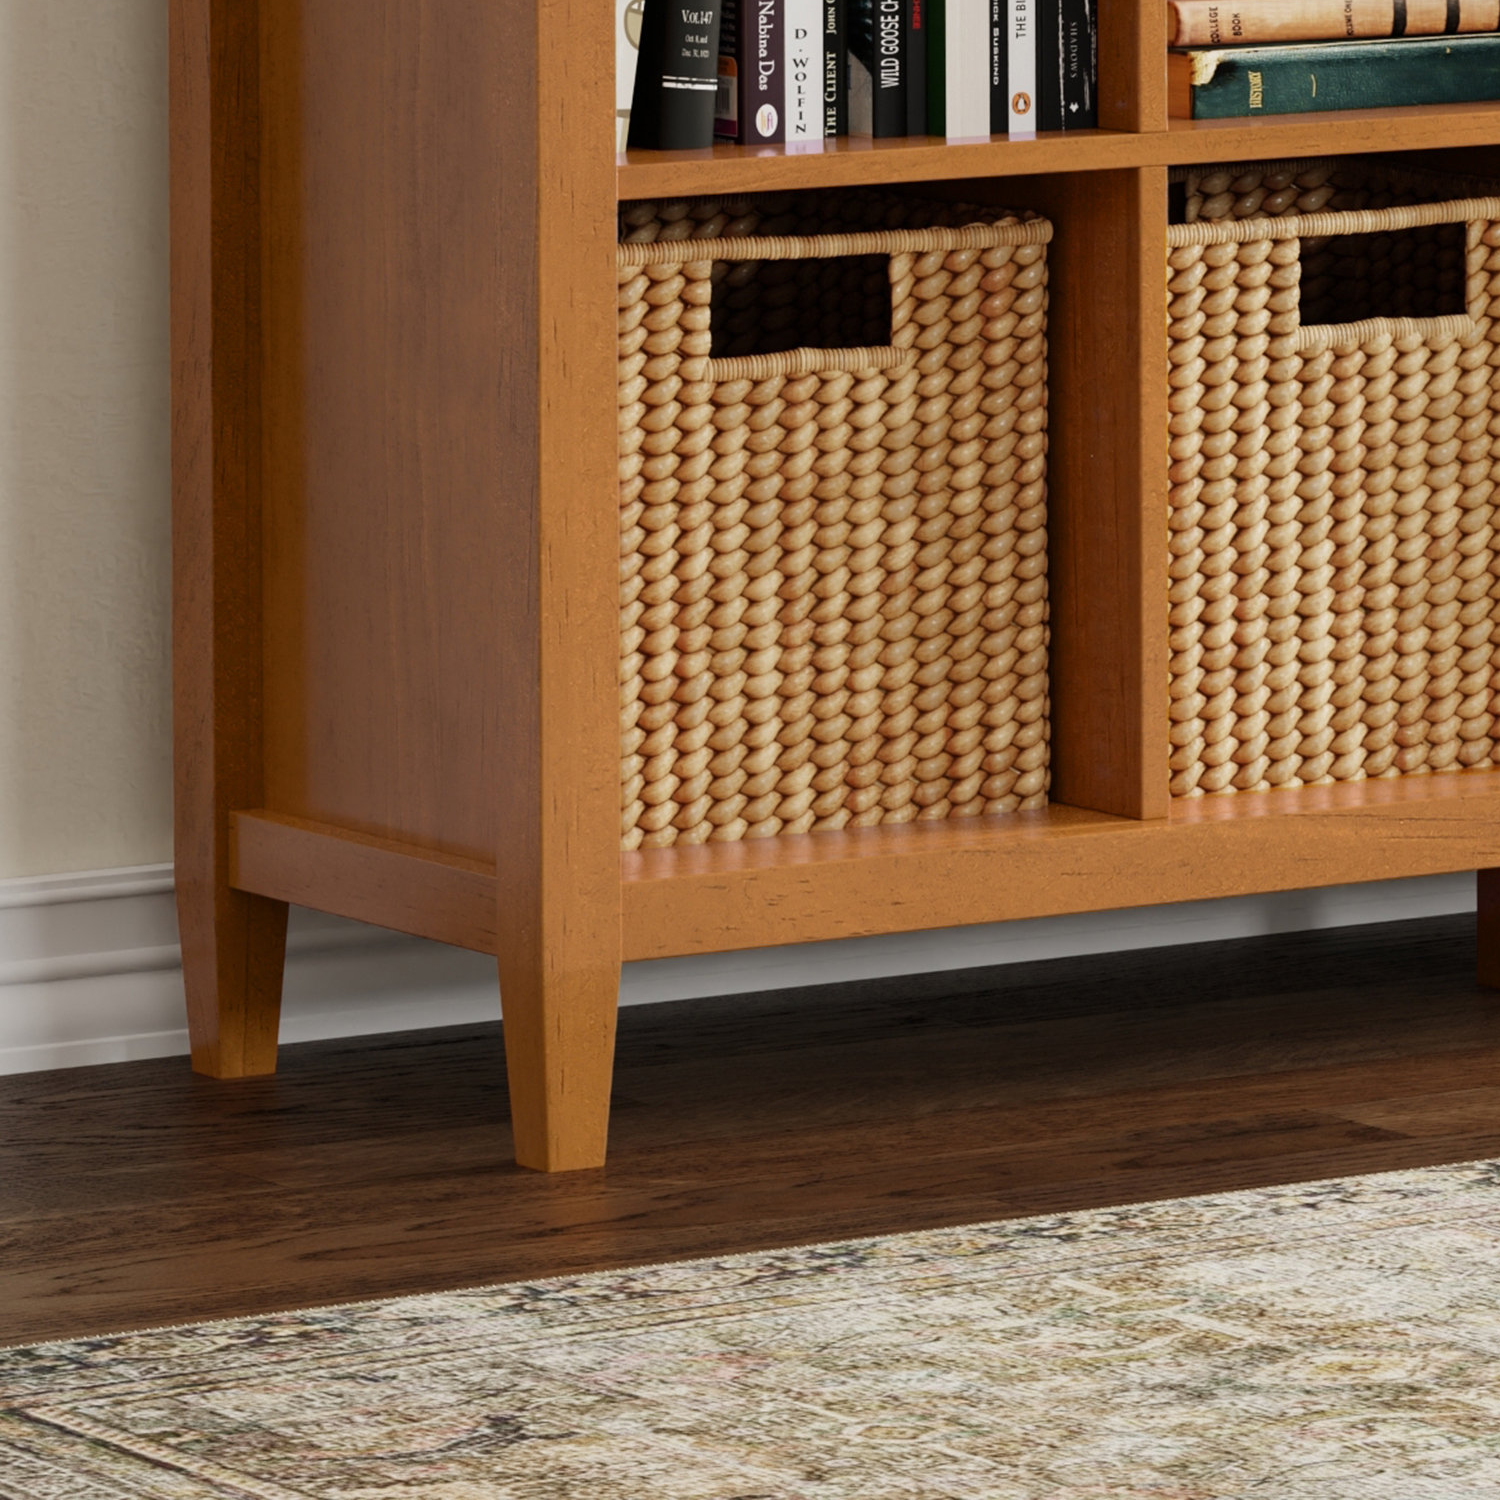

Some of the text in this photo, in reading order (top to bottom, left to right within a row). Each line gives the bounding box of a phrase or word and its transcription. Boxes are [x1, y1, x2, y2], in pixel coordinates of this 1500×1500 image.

[826, 6, 837, 34] JOHN
[880, 15, 900, 55] GOOSE
[1016, 17, 1026, 39] THE
[1209, 6, 1221, 44] COLLEGE
[1232, 13, 1243, 37] BOOK
[758, 0, 775, 91] Nabina Das
[1070, 21, 1078, 78] SHADOWS
[824, 51, 837, 102] CLIENT
[880, 58, 900, 89] WILD
[1248, 71, 1264, 108] HISTORY
[824, 106, 837, 136] THE
